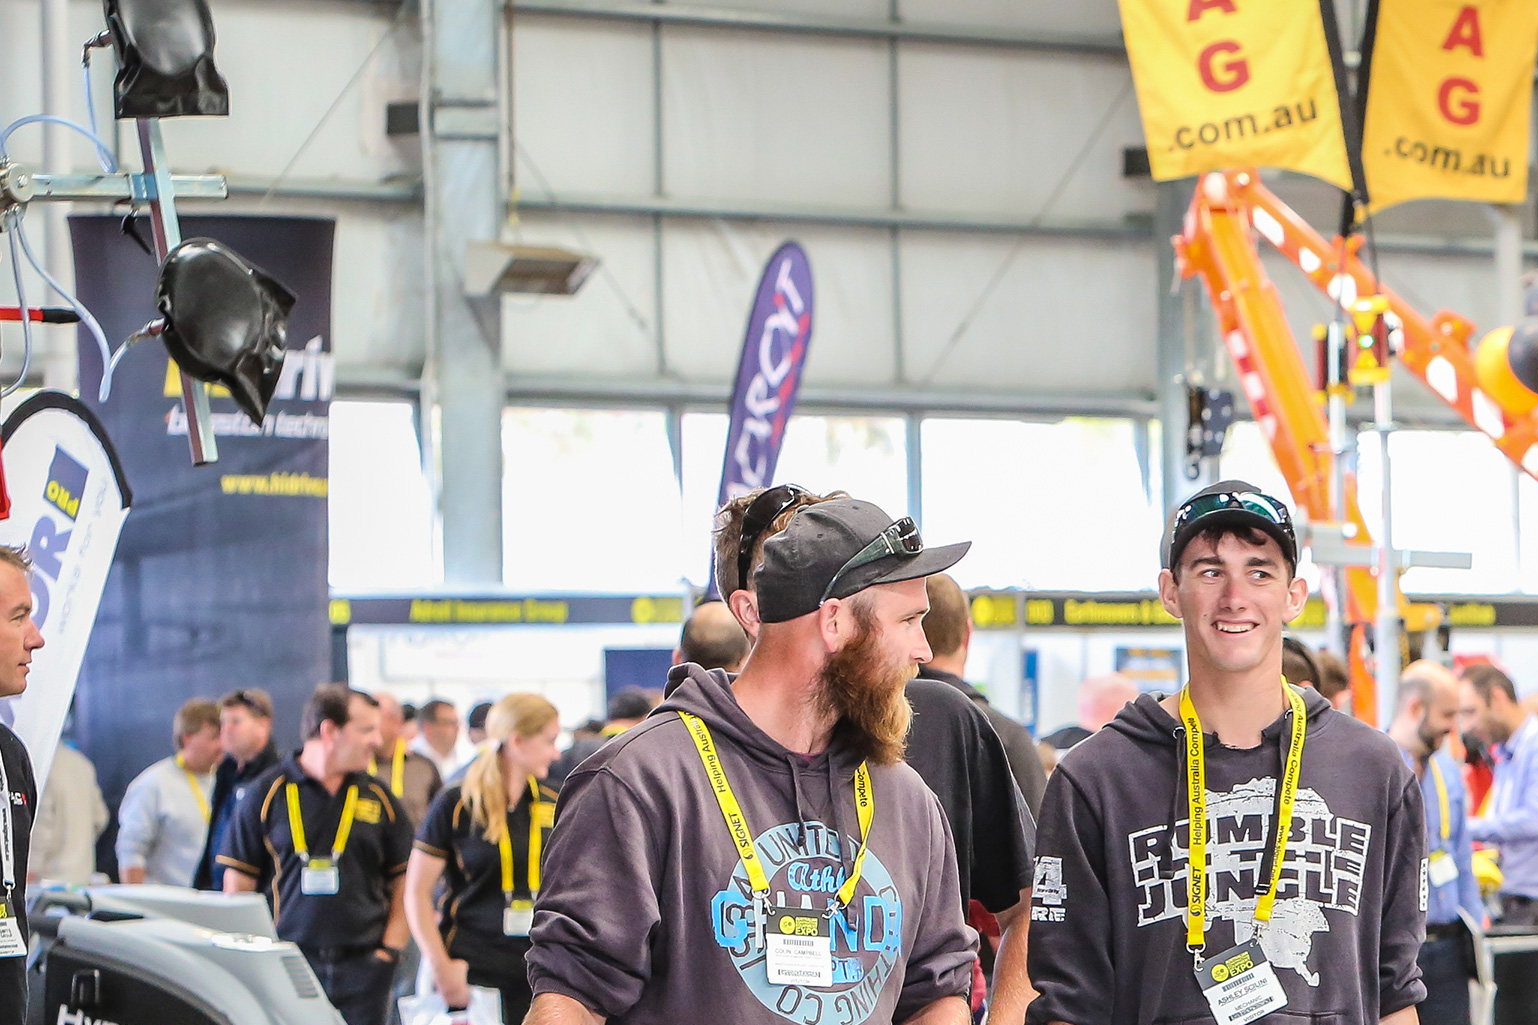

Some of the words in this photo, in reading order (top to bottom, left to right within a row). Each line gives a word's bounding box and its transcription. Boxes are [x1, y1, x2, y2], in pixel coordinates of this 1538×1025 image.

[1168, 98, 1318, 152] .com.au
[1384, 136, 1511, 178] .com.au
[1291, 714, 1304, 758] Australia
[708, 755, 727, 794] Helping
[1190, 759, 1201, 804] Australia
[728, 812, 750, 850] SIGNET
[1131, 816, 1370, 863] RUMBLE
[1193, 806, 1203, 846] Helping
[1139, 871, 1361, 919] JUNGLE
[1192, 866, 1202, 904] SIGNET
[795, 927, 819, 937] EXPO
[1229, 960, 1254, 977] EXPO
[1217, 988, 1244, 1006] ASHLEY
